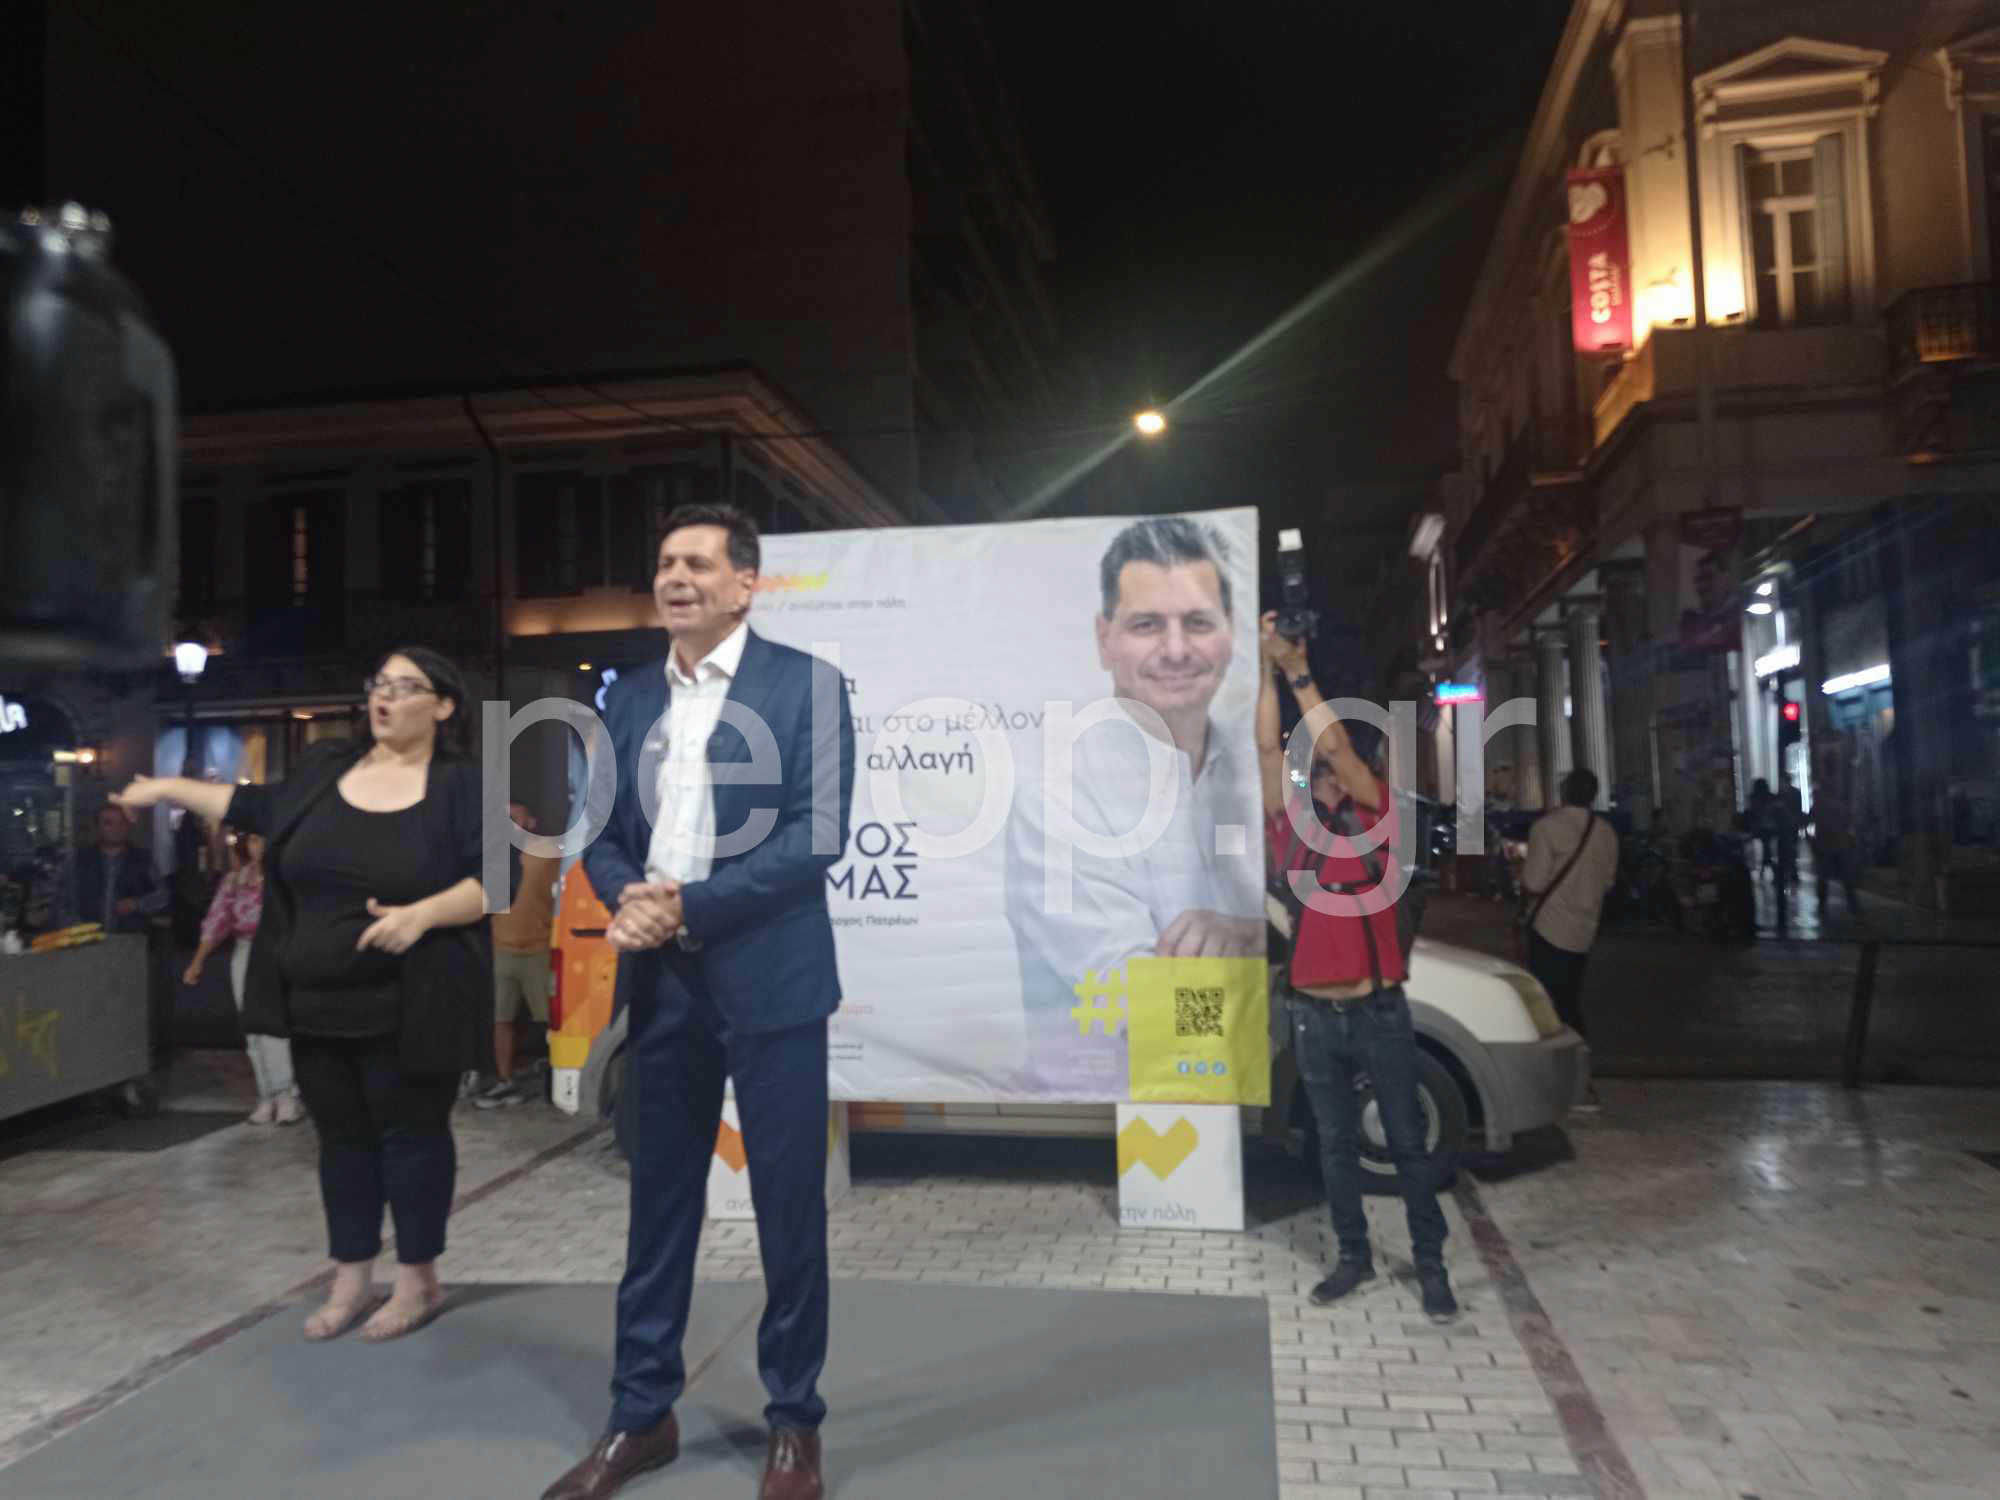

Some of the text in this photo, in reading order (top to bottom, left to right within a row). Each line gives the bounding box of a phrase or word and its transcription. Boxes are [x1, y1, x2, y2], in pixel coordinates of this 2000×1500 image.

[1588, 252, 1611, 323] COSTA
[883, 713, 935, 733] στο
[945, 704, 1045, 737] μέλλον
[867, 743, 974, 775] αλλαγή
[849, 822, 918, 857] ΟΣ
